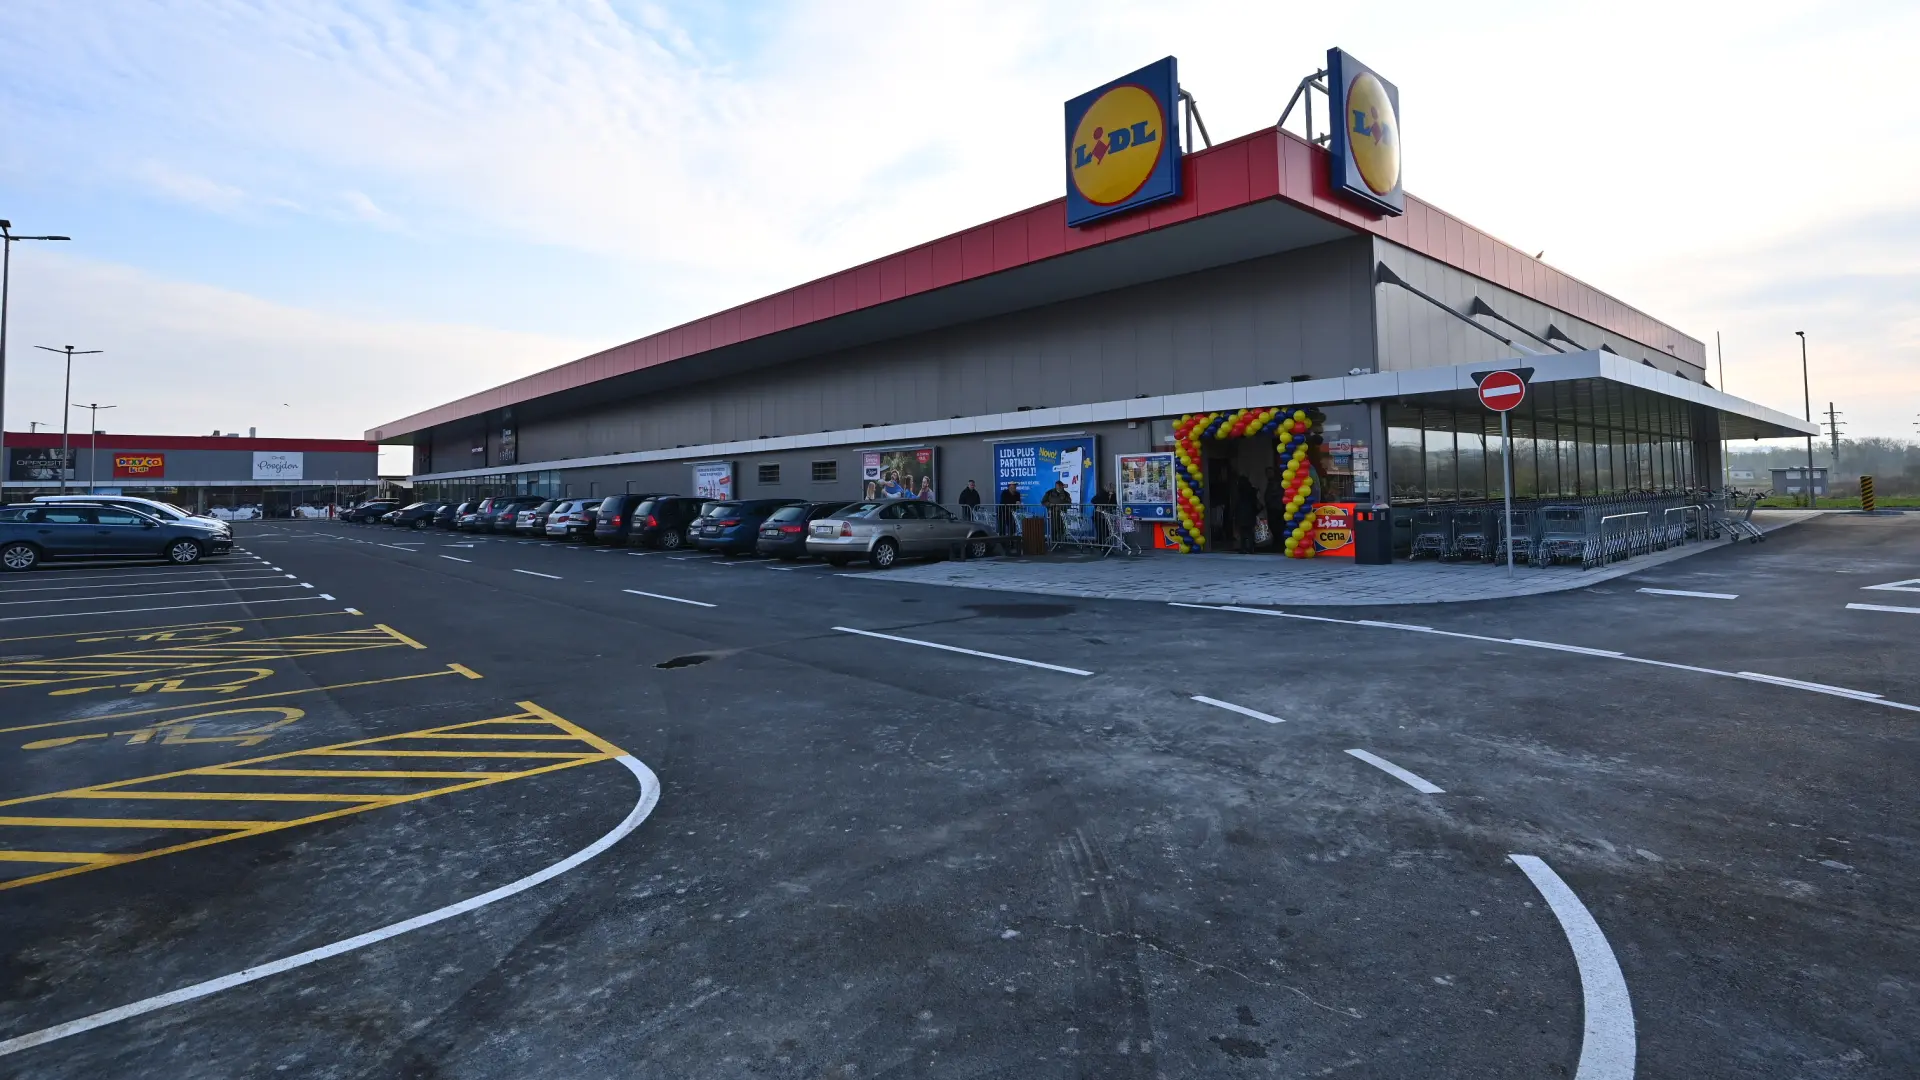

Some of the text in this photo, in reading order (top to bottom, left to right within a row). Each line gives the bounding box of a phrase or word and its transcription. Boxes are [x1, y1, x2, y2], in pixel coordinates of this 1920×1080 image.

[1000, 447, 1035, 458] LIDL PLUS
[257, 460, 299, 474] Posejdon
[1000, 457, 1036, 468] PARTNERI
[1000, 467, 1037, 478] SU STIGLI!
[1319, 531, 1346, 542] cena
